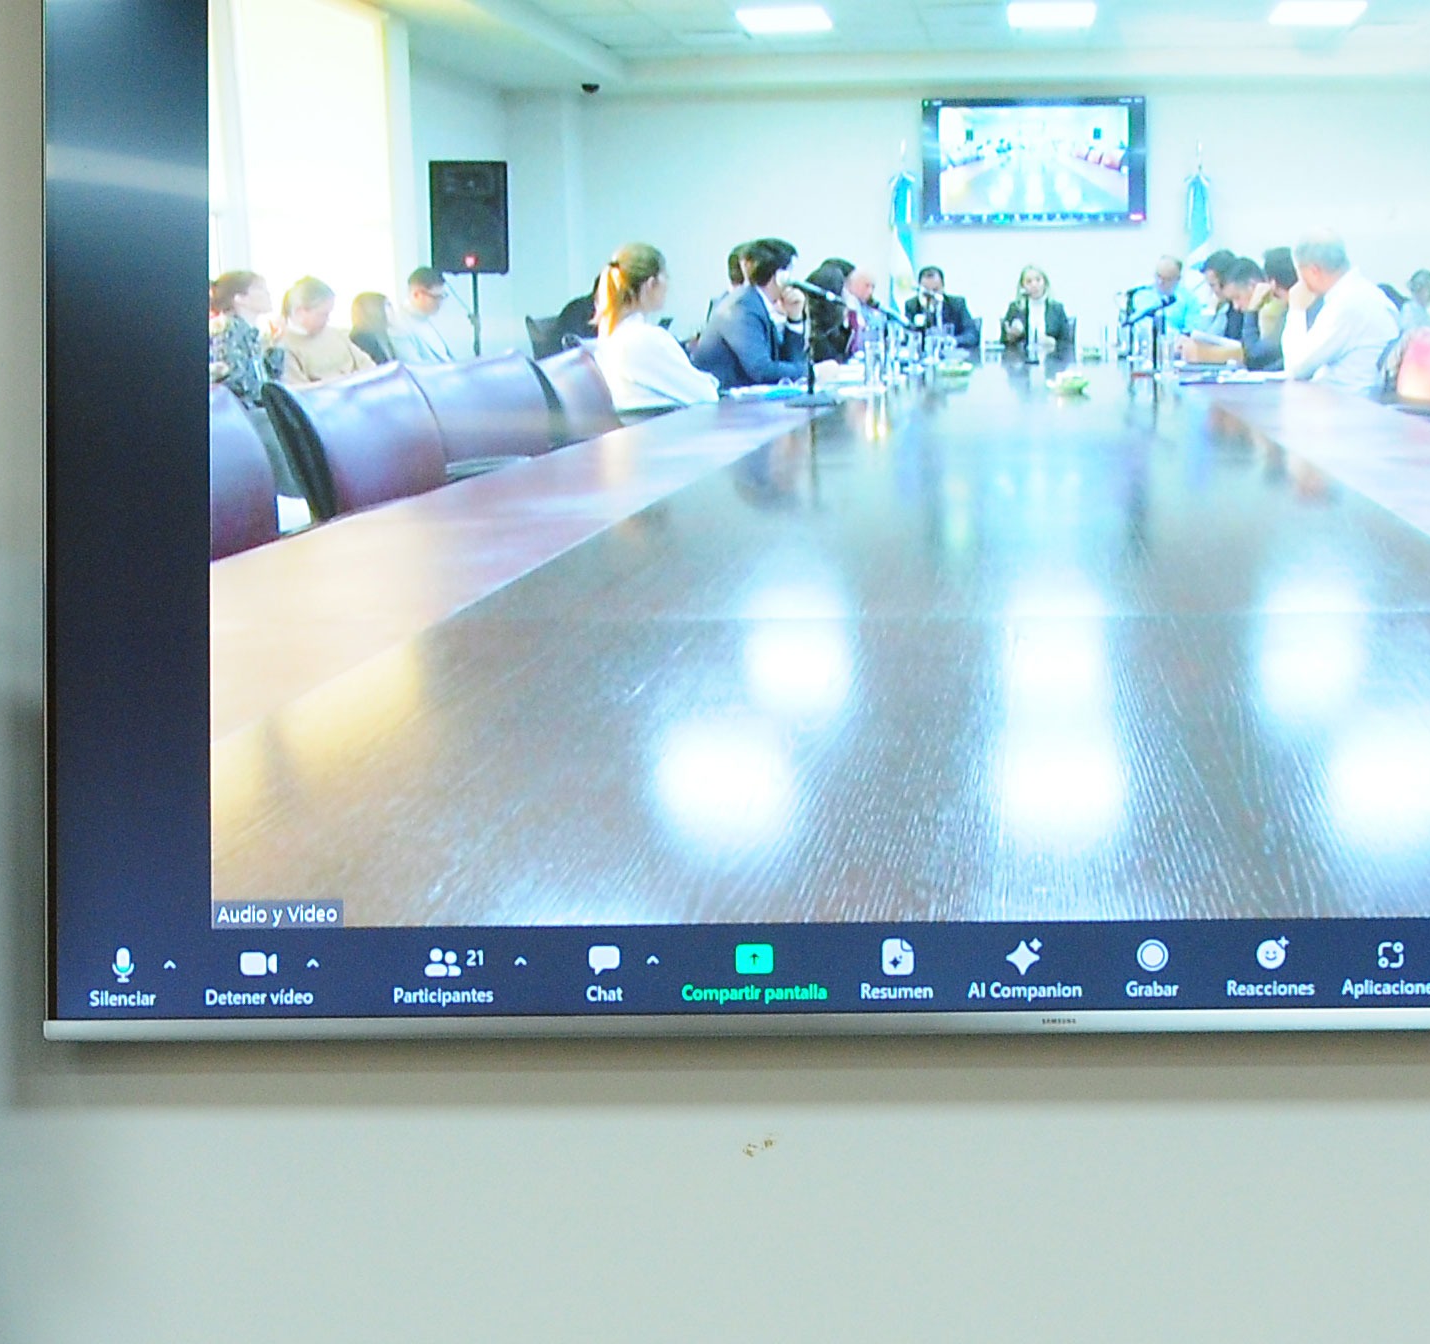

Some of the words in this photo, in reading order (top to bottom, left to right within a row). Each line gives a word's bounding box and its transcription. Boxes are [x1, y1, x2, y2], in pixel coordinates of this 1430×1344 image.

[217, 904, 268, 924] Audio
[272, 908, 283, 929] y
[286, 903, 338, 923] Video
[466, 949, 484, 967] 21
[586, 985, 623, 1002] Chat
[681, 984, 762, 1005] Compartir
[764, 983, 828, 1005] pantalla
[860, 982, 934, 1000] Resumen
[967, 981, 986, 999] AI
[989, 981, 1083, 1002] Companion
[1125, 980, 1179, 997] Grabar
[1226, 979, 1316, 996] Reacciones
[89, 989, 157, 1007] Silenciar
[205, 988, 268, 1006] Detener
[393, 987, 494, 1008] Participantes
